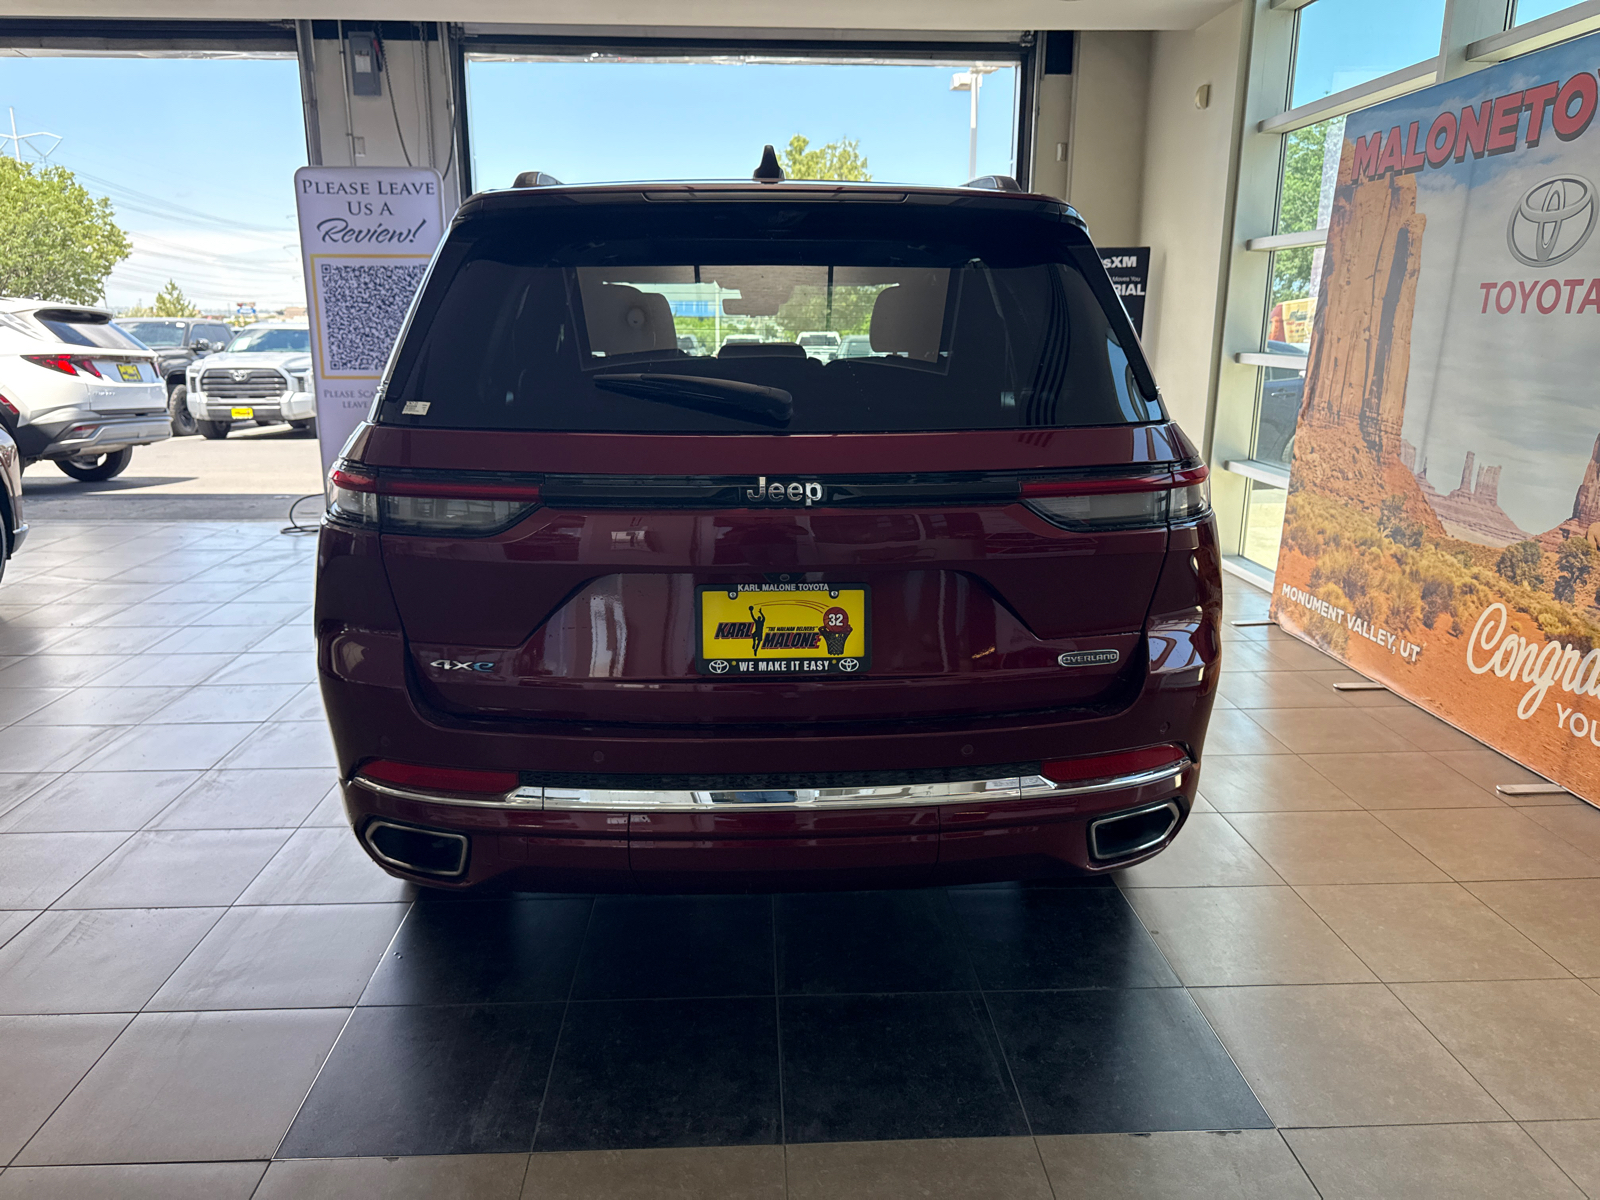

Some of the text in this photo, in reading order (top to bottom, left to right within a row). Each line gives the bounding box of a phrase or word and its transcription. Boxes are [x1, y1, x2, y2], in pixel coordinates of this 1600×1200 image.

[1351, 69, 1600, 184] MALONETO
[379, 201, 395, 216] A
[316, 218, 427, 243] Review!
[1101, 256, 1137, 268] sXM
[1480, 279, 1600, 314] TOYOTA
[746, 476, 823, 506] Jeep
[738, 583, 829, 592] KARL MALONE TOYOTA
[828, 613, 844, 626] 32
[1281, 583, 1421, 662] MONUMENT VALLEY, UT
[714, 622, 755, 639] KARL
[761, 632, 821, 649] MALONE
[739, 660, 830, 671] WE MAKE IT EASY
[1063, 653, 1117, 663] OVERLAND
